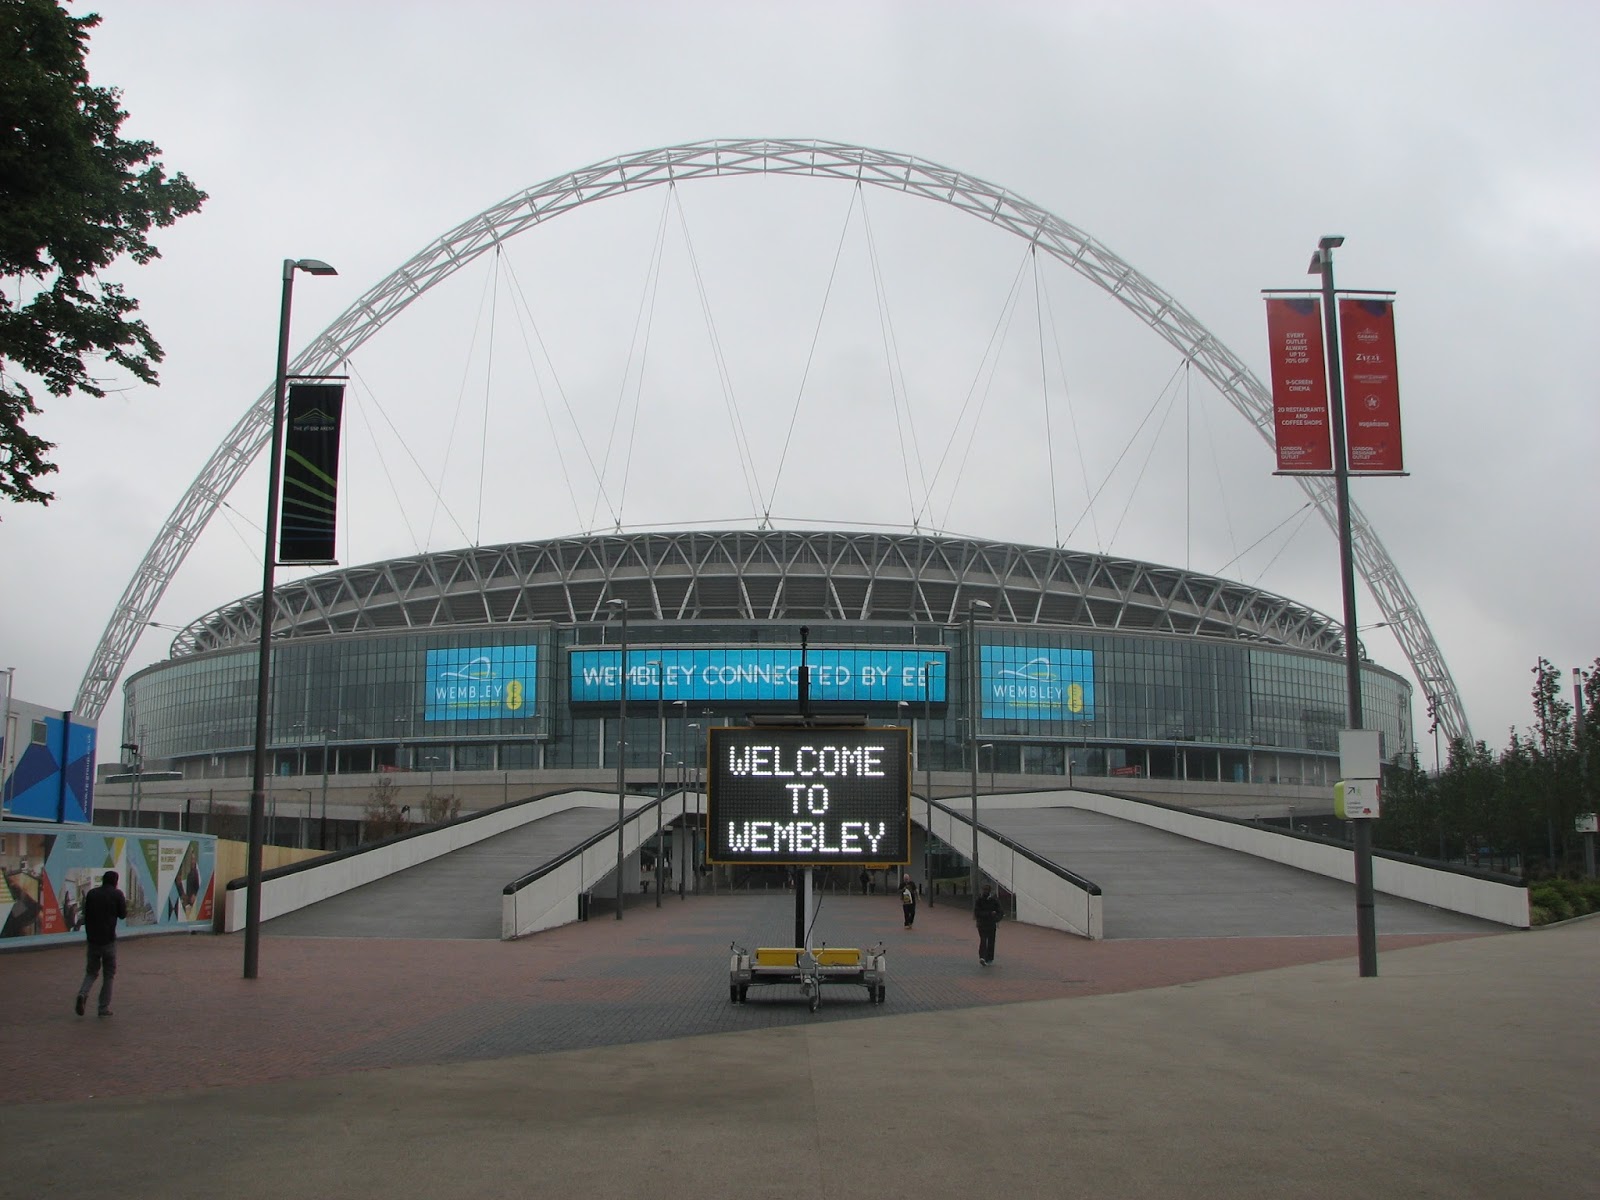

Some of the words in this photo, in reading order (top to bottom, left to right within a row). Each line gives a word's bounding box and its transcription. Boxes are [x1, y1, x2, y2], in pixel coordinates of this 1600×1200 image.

[1356, 353, 1380, 362] Zizzi
[584, 665, 697, 686] WEMBLEY
[702, 664, 850, 686] CONNECTED
[862, 666, 892, 686] BY
[902, 666, 926, 686] EE
[993, 684, 1063, 699] WEMBLEY
[729, 746, 885, 776] WELCOME
[785, 784, 829, 814] TO
[728, 821, 886, 852] WEMBLEY
